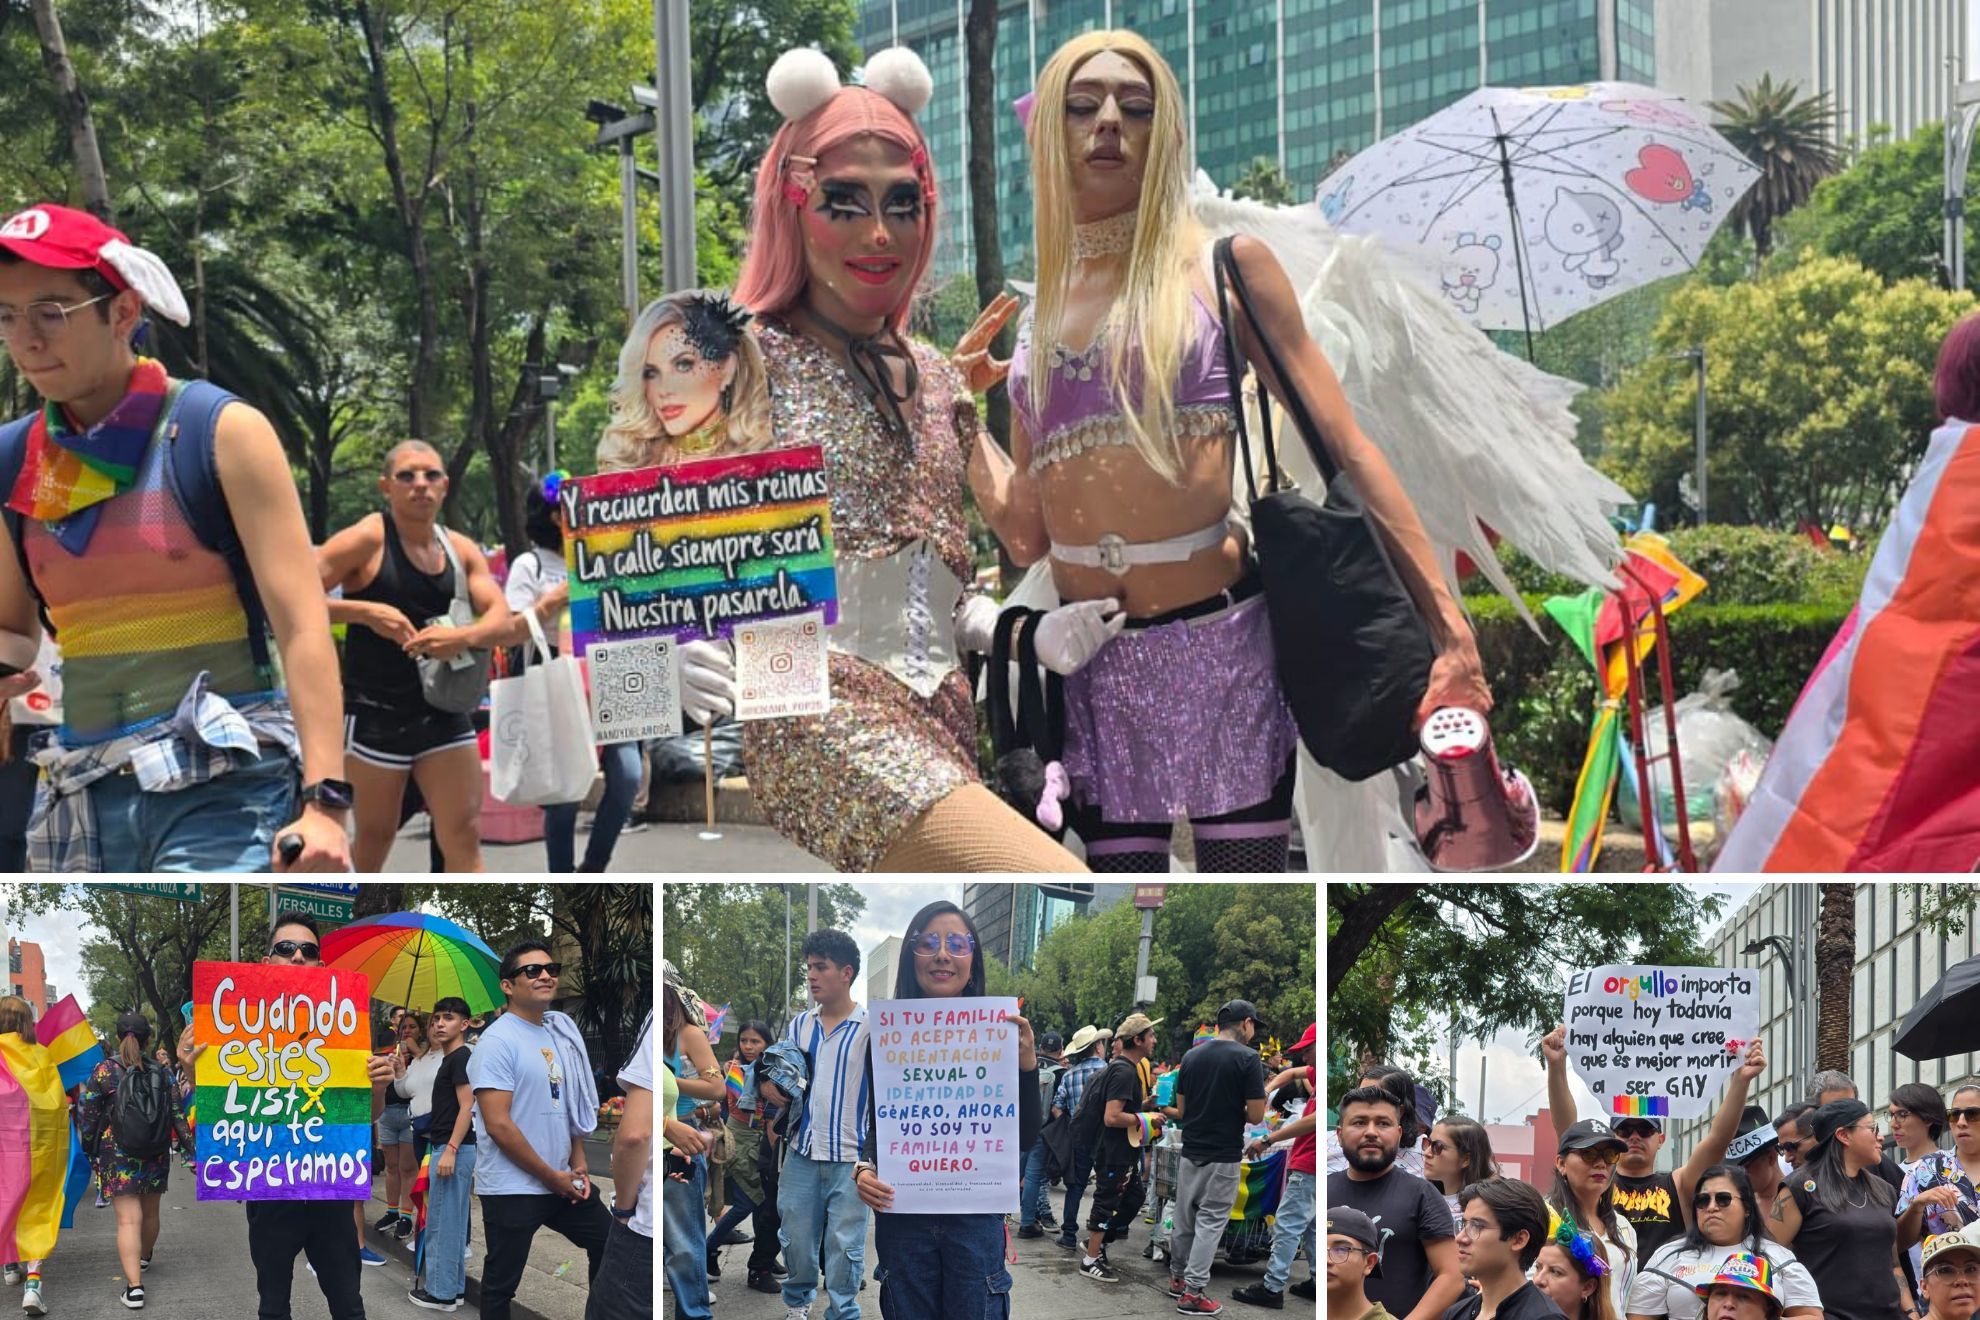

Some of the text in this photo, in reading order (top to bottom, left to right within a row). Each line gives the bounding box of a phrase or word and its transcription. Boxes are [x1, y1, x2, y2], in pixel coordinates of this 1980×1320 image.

[563, 470, 827, 528] Y recuerden mis reinas
[577, 517, 822, 582] La calle siempre será
[602, 570, 808, 636] Nuestra pasarela.
[1567, 970, 1751, 1000] El orgullo importa
[212, 975, 357, 1036] Cuando
[879, 1008, 1008, 1026] SI TU FAMILIA
[1571, 995, 1732, 1028] porque hoy todavía
[879, 1028, 1008, 1047] NO ACEPTA TU
[1569, 1028, 1725, 1054] hay alguien que cree
[218, 1031, 331, 1086] estés
[1581, 1050, 1737, 1072] que es mejor morir
[903, 1066, 987, 1082] SEXUAL O
[1592, 1074, 1707, 1098] a ser GAY
[886, 1084, 1004, 1102] IDENTIDAD DE
[958, 1103, 1016, 1119] AHORA
[287, 1110, 324, 1144] te
[900, 1122, 992, 1136] YO SOY TU
[889, 1139, 1004, 1155] FAMILIA Y TE
[203, 1149, 368, 1190] esperamos
[909, 1158, 978, 1173] QUIERO.
